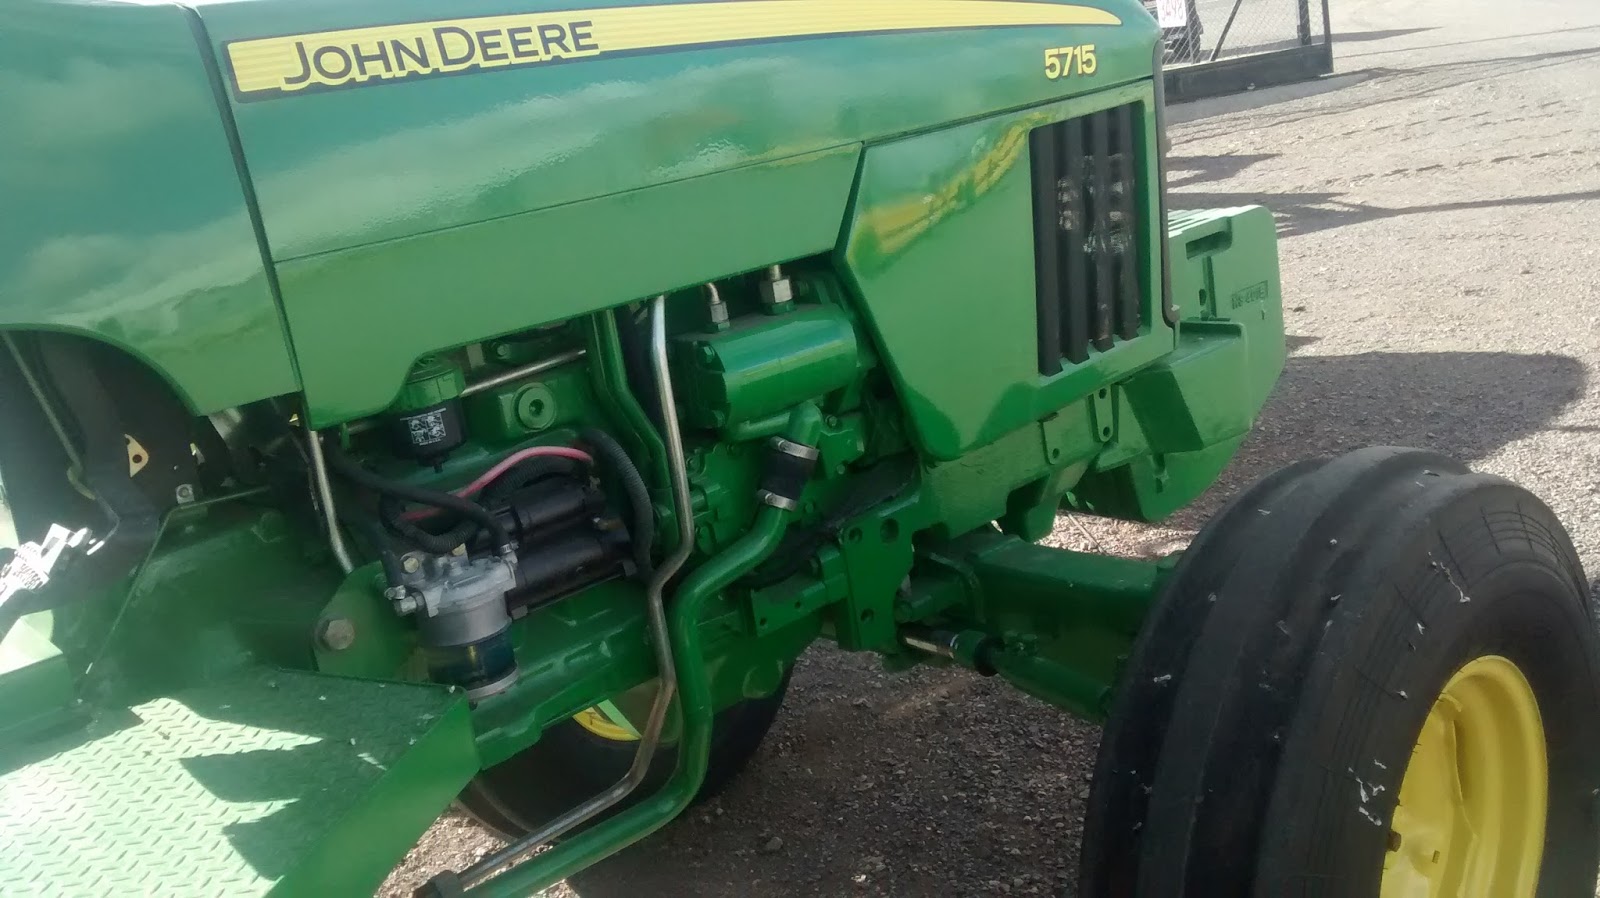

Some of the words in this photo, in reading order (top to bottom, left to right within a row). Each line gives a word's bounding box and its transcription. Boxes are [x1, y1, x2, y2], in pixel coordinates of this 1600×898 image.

[284, 37, 430, 85] JOHN
[433, 20, 599, 66] DEERE
[1044, 44, 1097, 79] 5715
